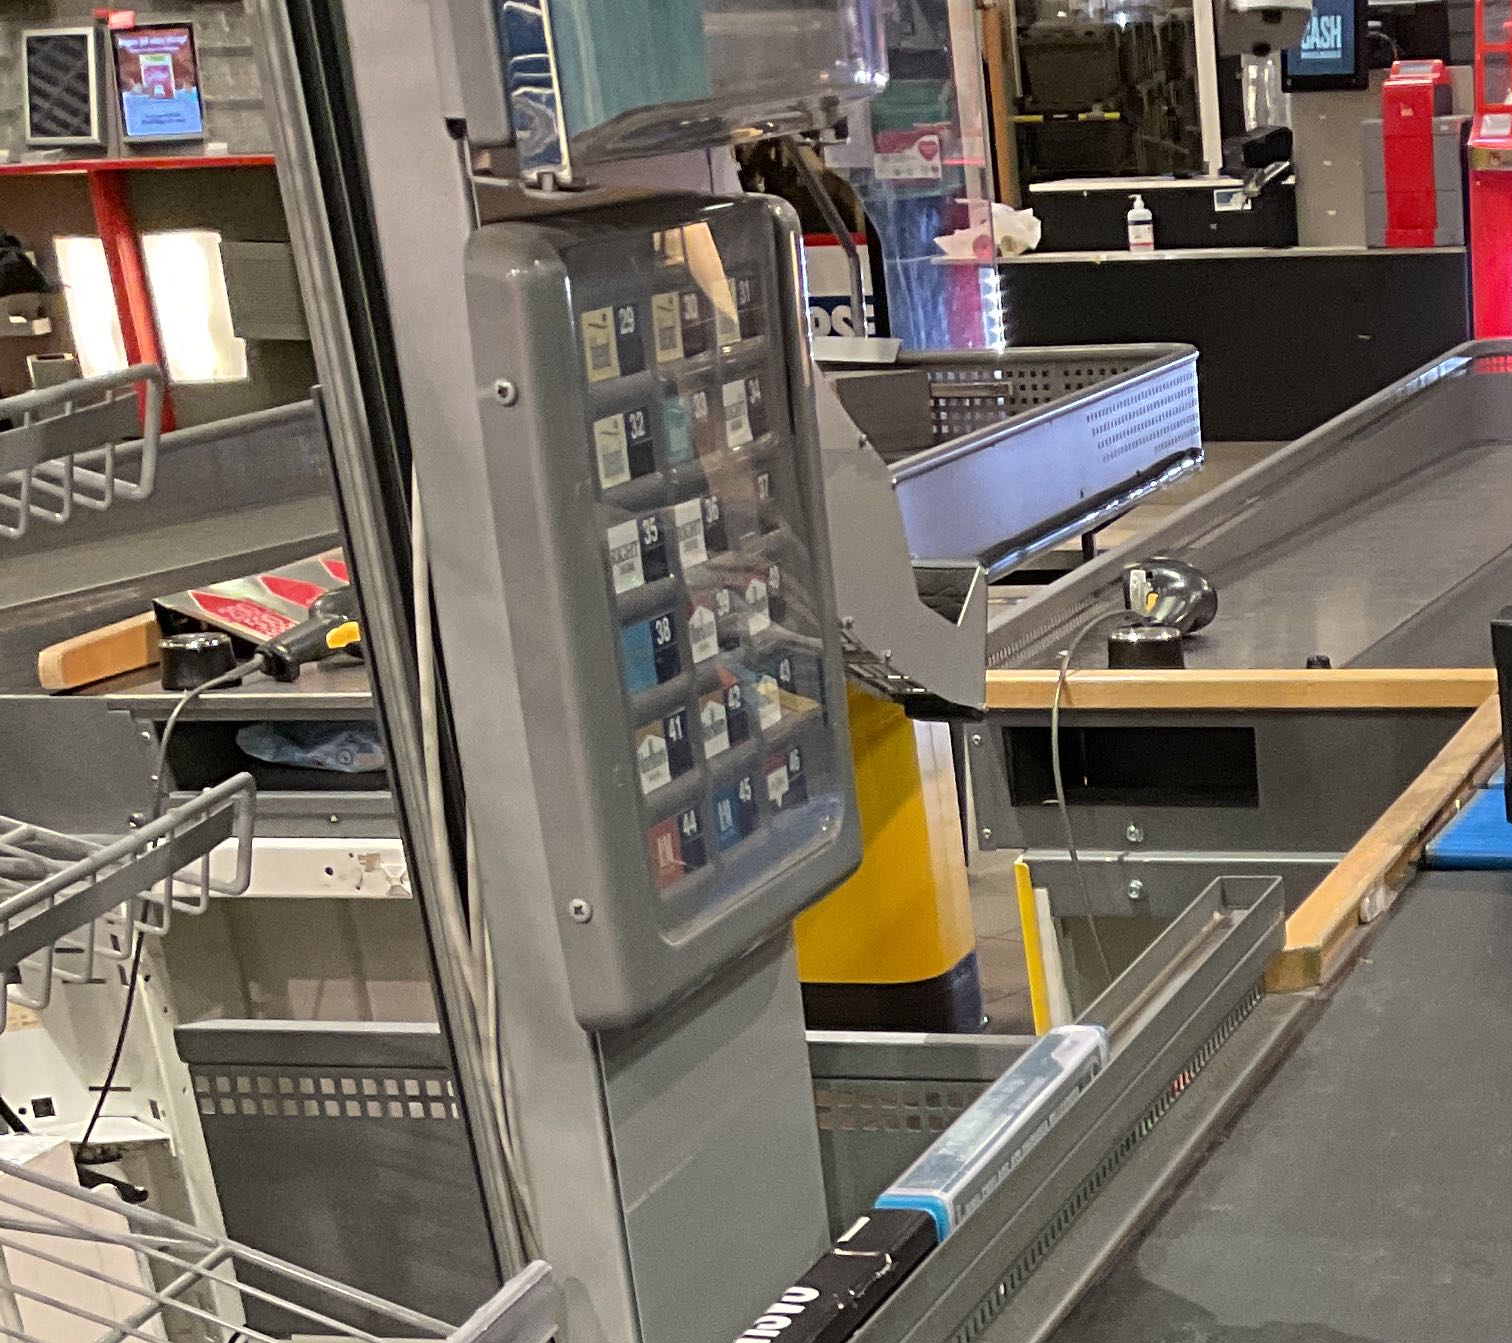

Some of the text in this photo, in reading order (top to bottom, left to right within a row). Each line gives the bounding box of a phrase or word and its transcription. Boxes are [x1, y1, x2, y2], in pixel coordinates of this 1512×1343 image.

[629, 410, 646, 439] 32
[642, 516, 659, 545] 35
[655, 616, 672, 645] 38
[669, 714, 683, 742] 41
[683, 810, 697, 836] 44
